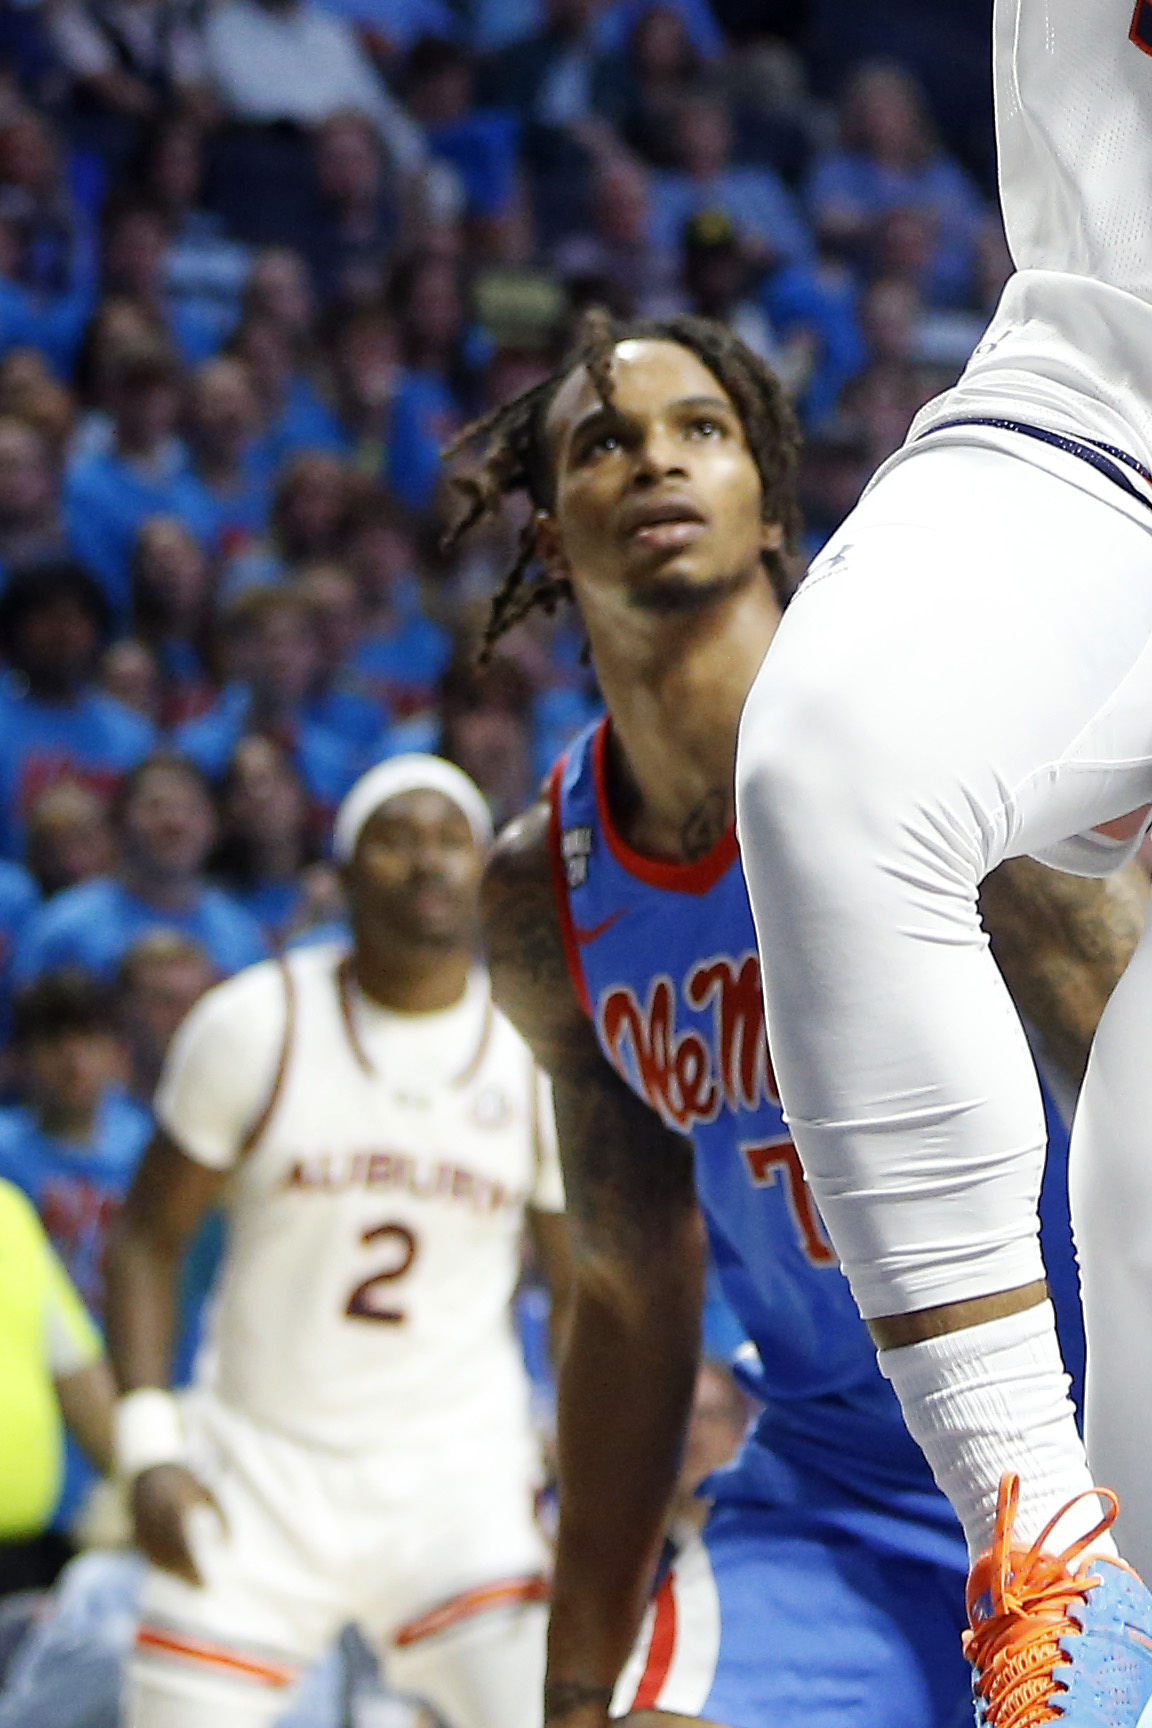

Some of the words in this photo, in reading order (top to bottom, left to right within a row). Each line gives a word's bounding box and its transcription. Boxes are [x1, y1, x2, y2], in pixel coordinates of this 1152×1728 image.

[274, 1145, 514, 1218] AUBURN
[739, 1135, 837, 1268] 7
[343, 1220, 420, 1329] 2
